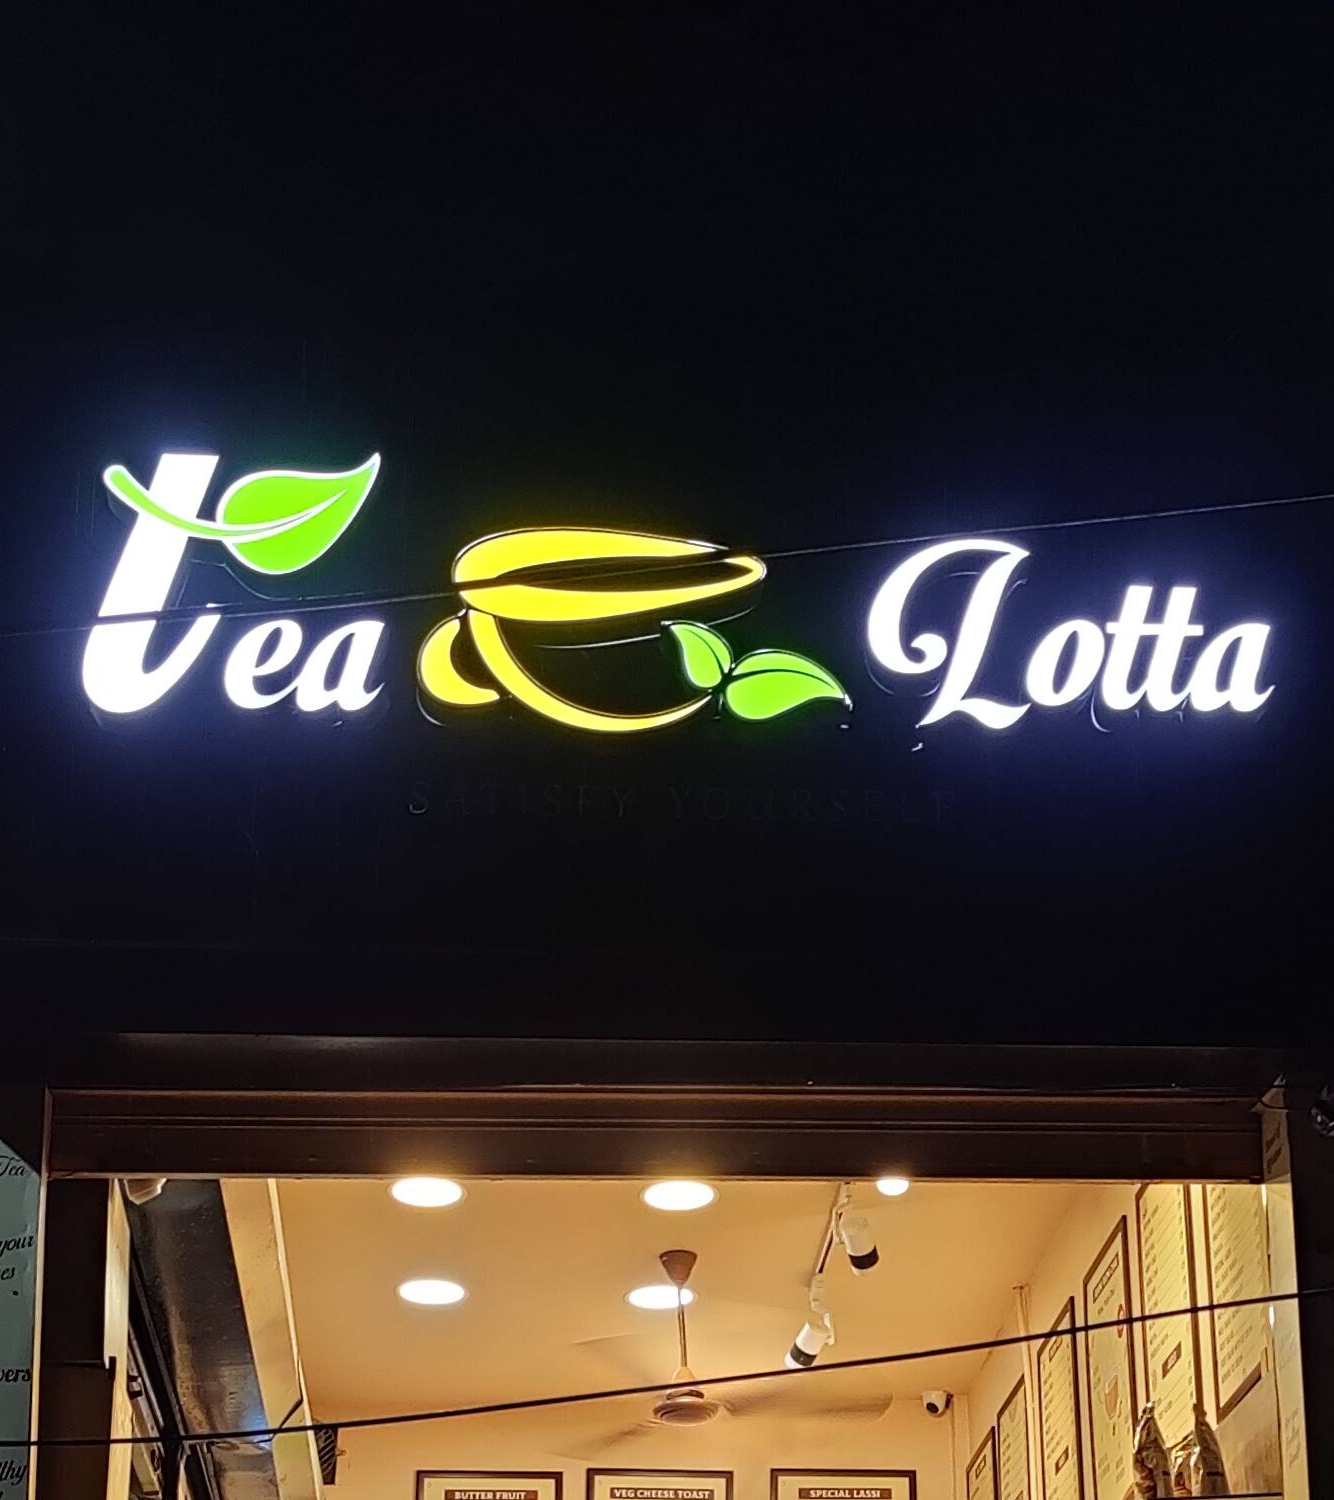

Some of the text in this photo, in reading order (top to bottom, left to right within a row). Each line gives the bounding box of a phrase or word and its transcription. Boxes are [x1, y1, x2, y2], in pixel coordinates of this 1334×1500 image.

[868, 539, 1275, 728] Lotta
[454, 1492, 526, 1500] BUTTER FRUIT
[614, 1489, 710, 1499] VEG CHEESE TOAST
[810, 1490, 880, 1498] SPECIAL LASSI
